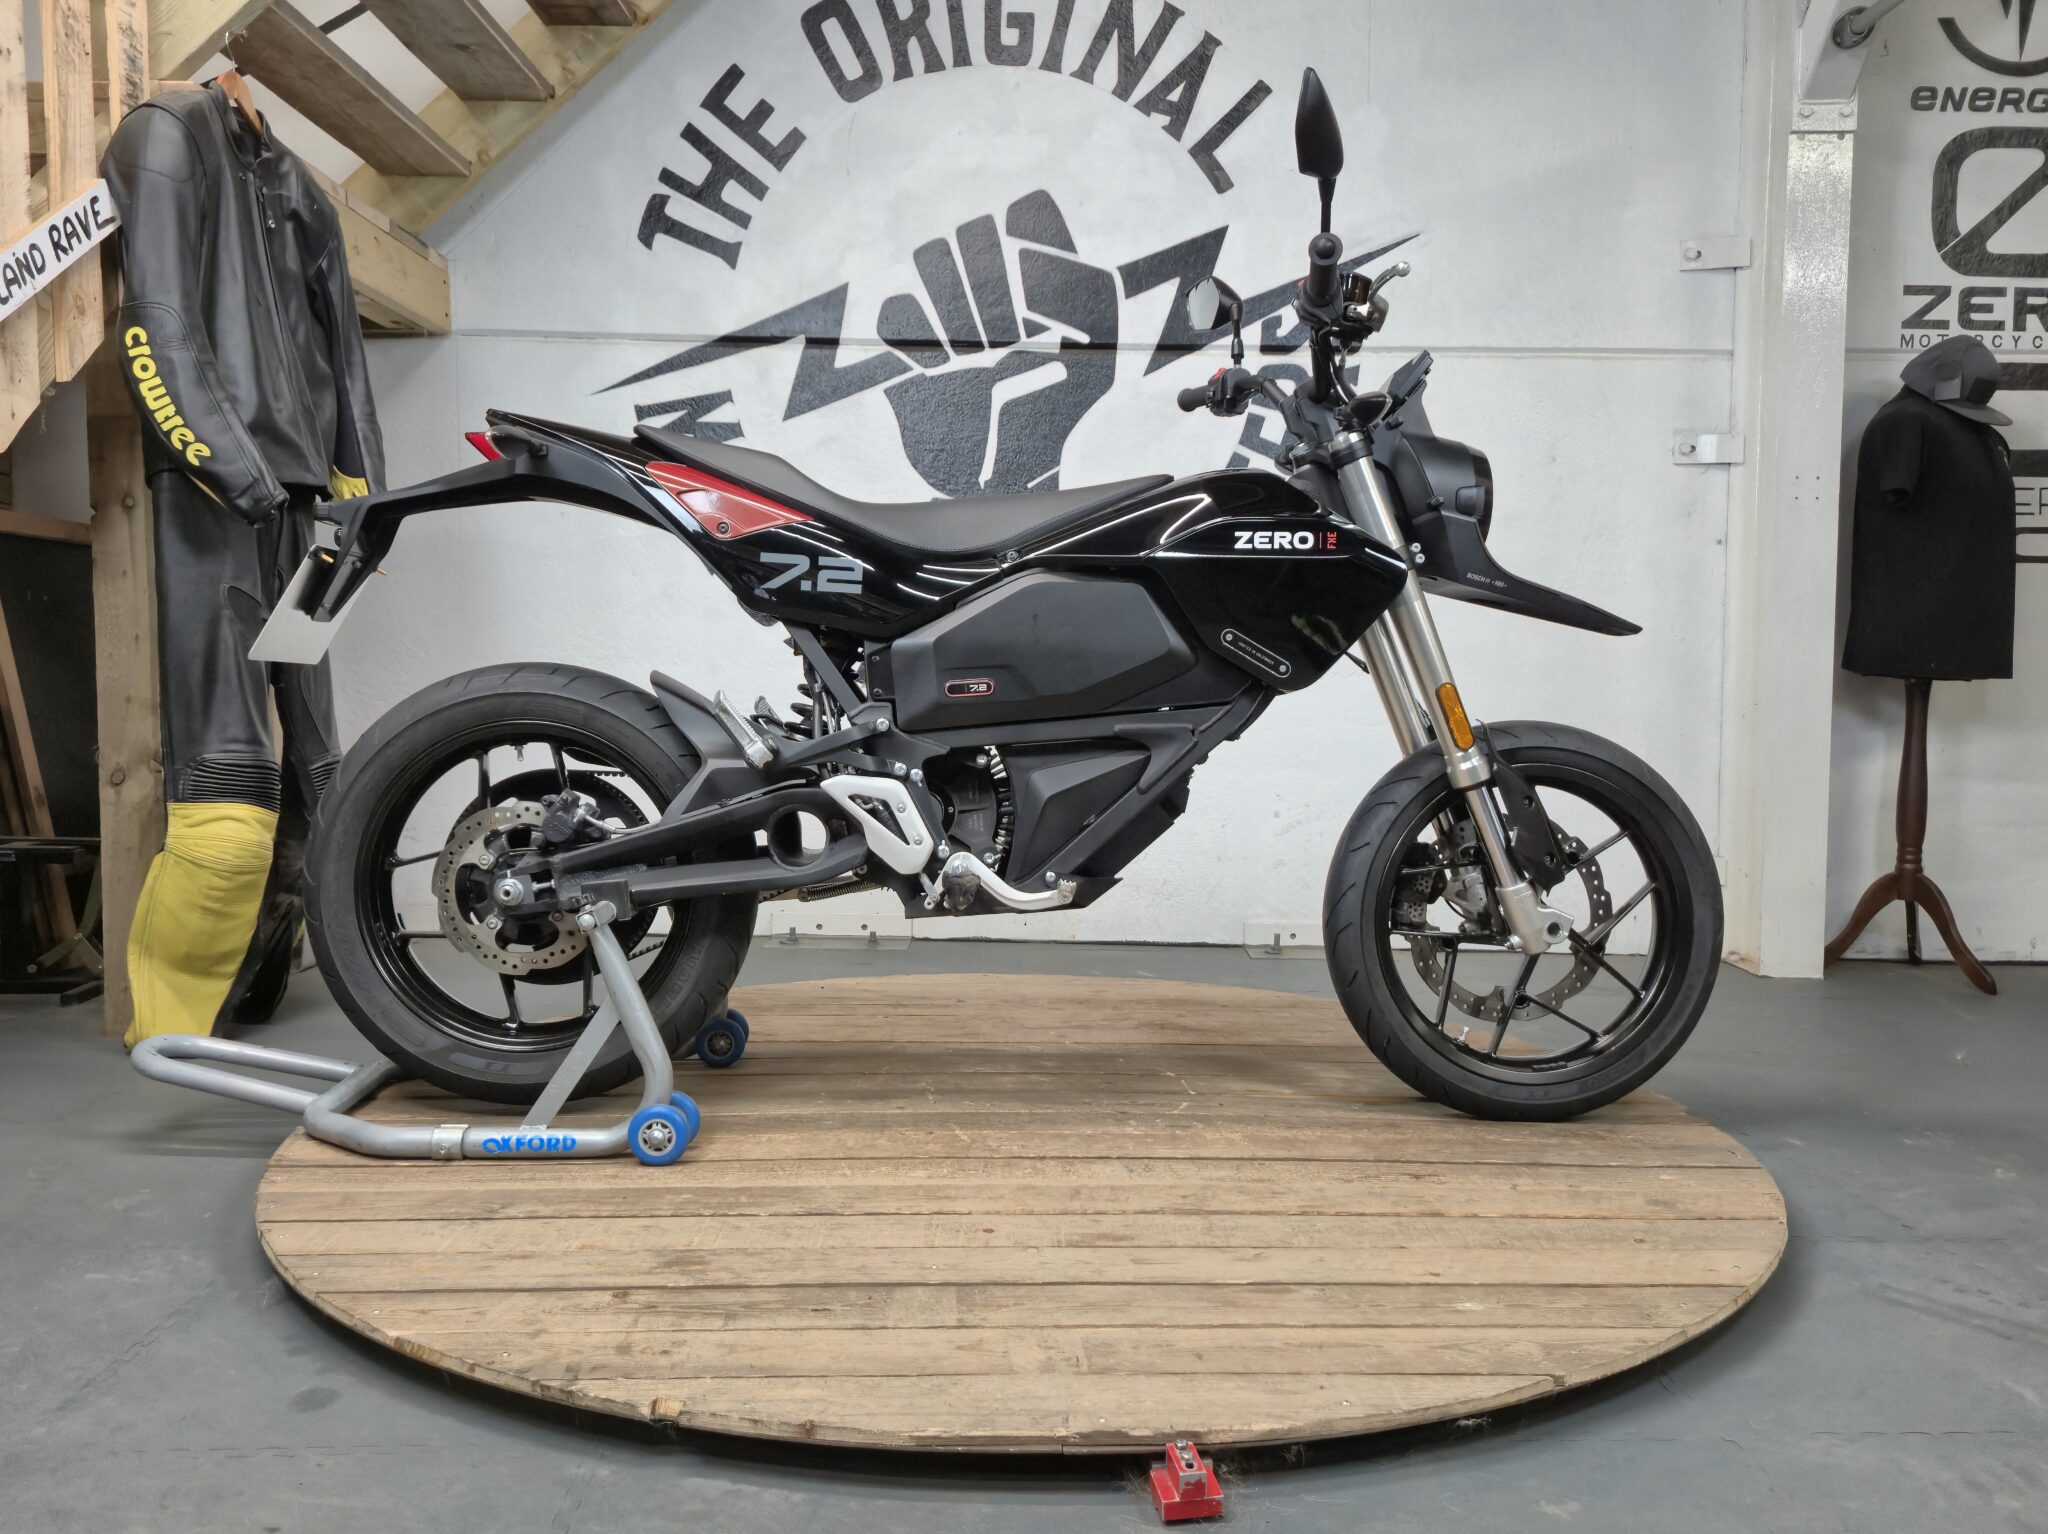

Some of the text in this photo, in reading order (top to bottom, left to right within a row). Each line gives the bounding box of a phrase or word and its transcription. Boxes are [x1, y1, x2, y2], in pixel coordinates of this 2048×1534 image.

[637, 0, 1273, 270] THE ORIGINAL
[48, 195, 116, 263] RAVE
[1900, 334, 2044, 349] MOTCYC
[1234, 531, 1337, 549] ZERO FXE
[760, 551, 863, 594] 7.2
[969, 683, 988, 691] 7.2
[481, 1134, 577, 1155] OXFORD
